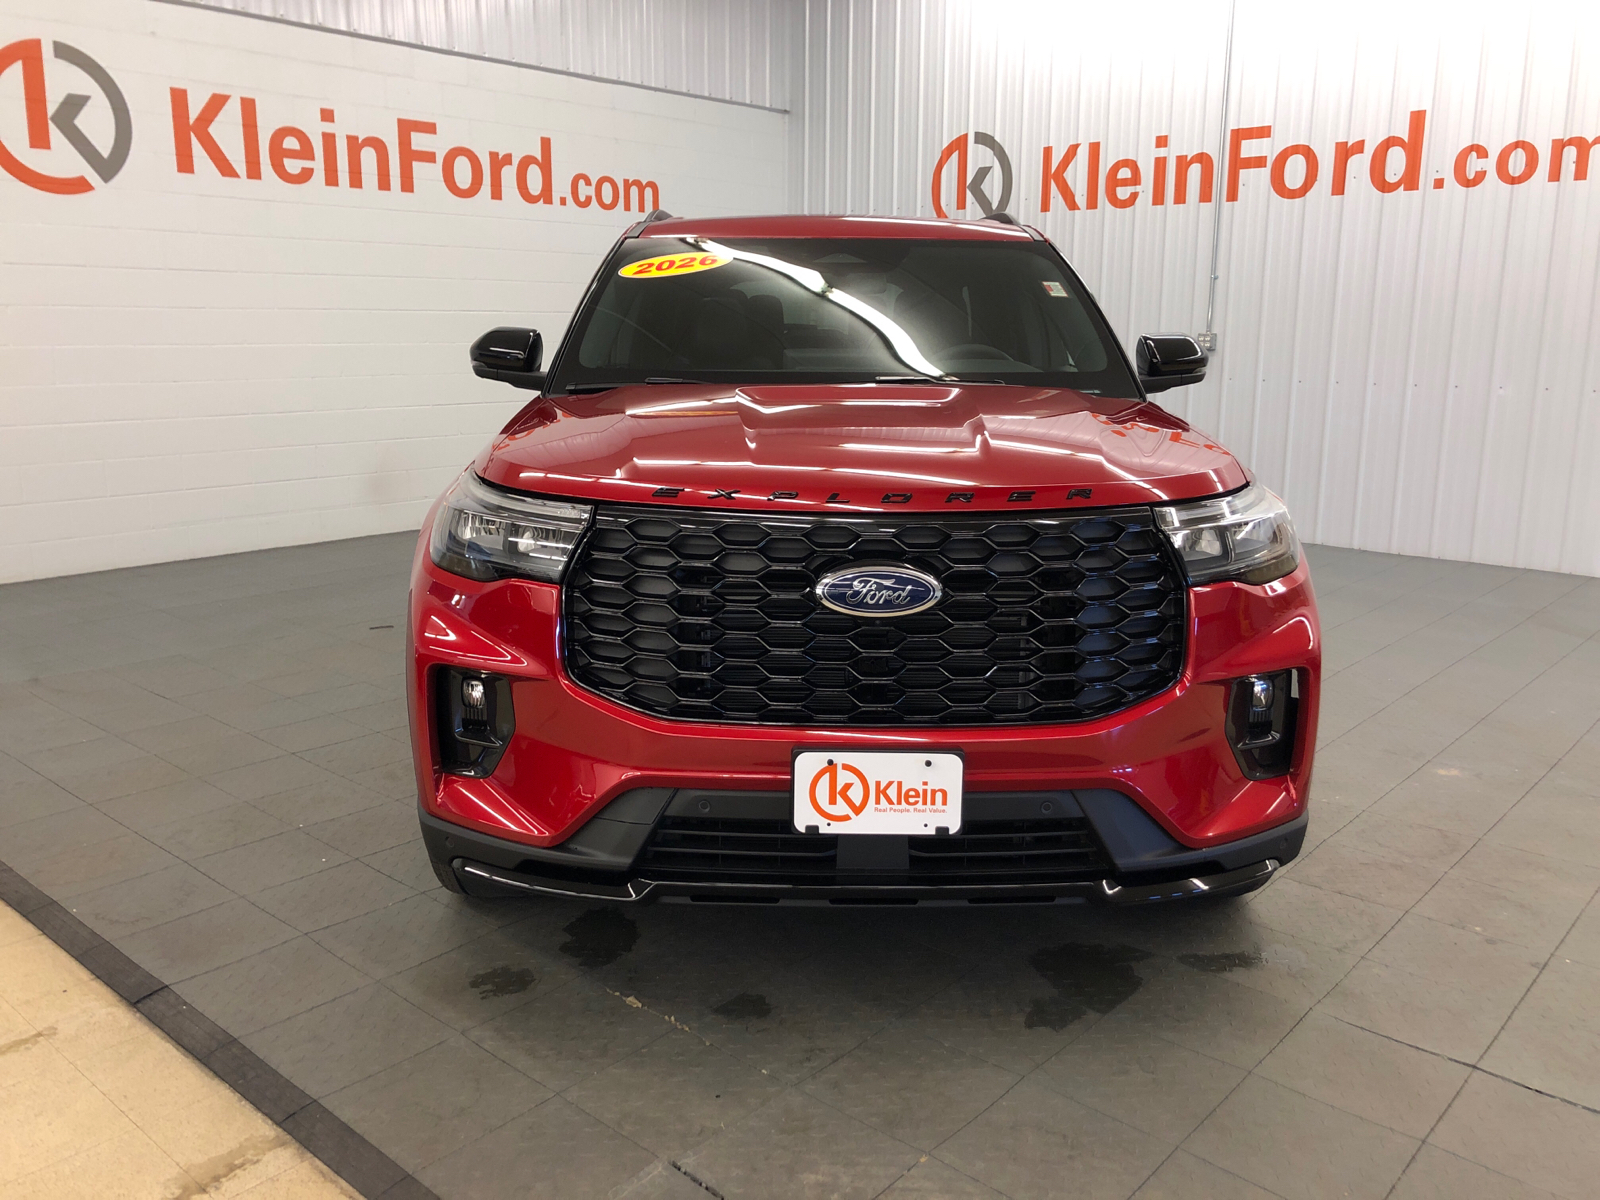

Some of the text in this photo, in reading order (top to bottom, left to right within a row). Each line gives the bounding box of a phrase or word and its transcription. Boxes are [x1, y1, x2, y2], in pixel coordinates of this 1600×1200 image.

[169, 86, 660, 213] KleinFord.com
[1040, 109, 1600, 213] KleinFord.com
[632, 255, 718, 275] 2026
[651, 486, 1094, 504] EXPLORER
[846, 577, 912, 605] Ford
[874, 780, 948, 806] Klein
